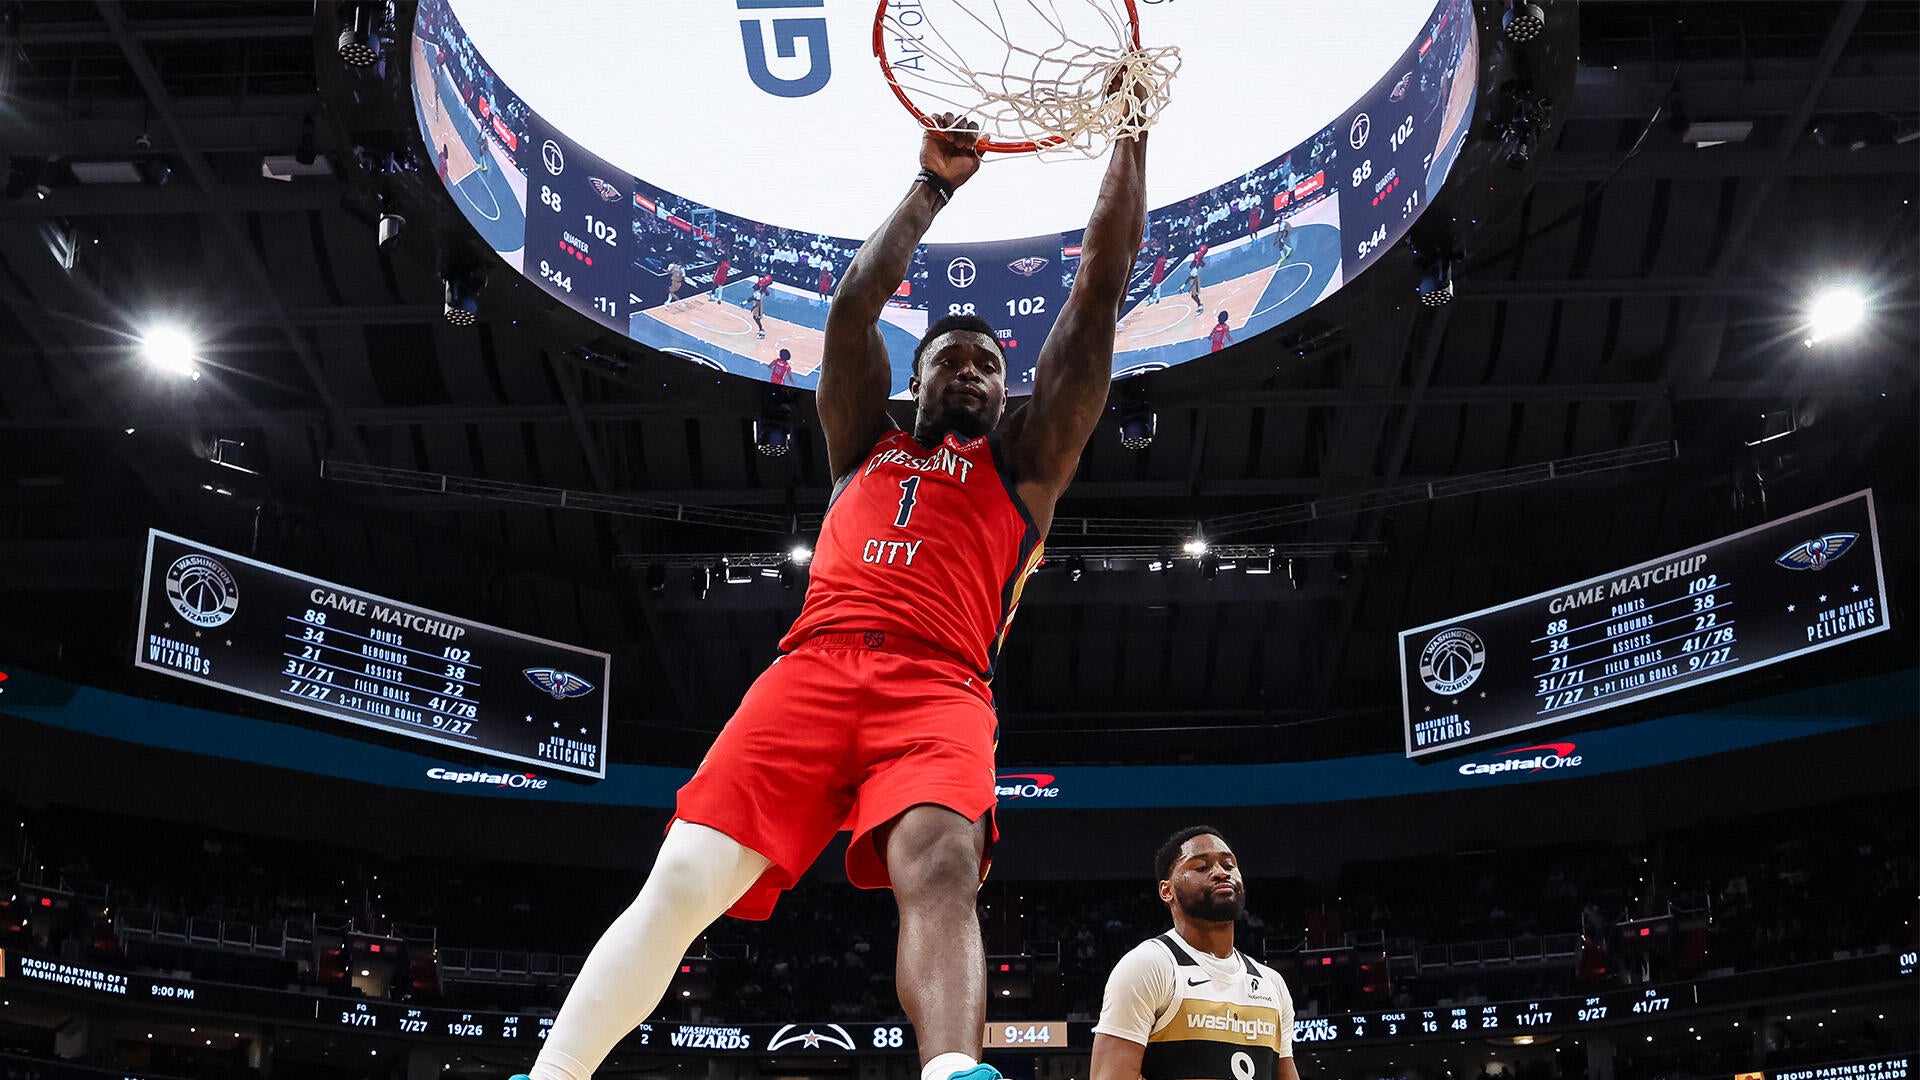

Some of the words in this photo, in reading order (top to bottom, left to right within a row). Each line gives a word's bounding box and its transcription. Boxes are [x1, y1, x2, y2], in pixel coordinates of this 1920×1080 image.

[893, 34, 925, 71] Art
[1390, 115, 1413, 152] 102
[1352, 159, 1372, 187] 88
[541, 185, 562, 213] 88
[585, 215, 617, 247] 102
[1358, 223, 1387, 259] 9:44
[563, 231, 589, 254] QUARTER
[540, 260, 573, 293] 9:44
[594, 296, 616, 317] :11
[948, 303, 976, 316] 88
[1006, 297, 1046, 317] 102
[864, 447, 975, 484] CRESCENT
[893, 475, 921, 528] 1
[862, 538, 923, 566] CITY
[176, 557, 231, 584] WASHINGTON
[1548, 585, 1605, 615] GAME
[1609, 554, 1708, 598] MATCHUP
[178, 603, 222, 623] WIZARDS
[310, 588, 368, 617] GAME
[370, 605, 466, 641] MATCHUP
[1546, 618, 1568, 636] 88
[1611, 598, 1645, 617] POINTS
[1688, 574, 1717, 595] 102
[1818, 609, 1836, 622] NEW
[1839, 597, 1874, 615] ORLEANS
[1548, 636, 1570, 653] 34
[1606, 614, 1654, 637] REBOUNDS
[1692, 594, 1715, 612] 38
[1807, 608, 1875, 642] PELICANS
[150, 634, 200, 656] WASHINGTON
[304, 609, 327, 625] 88
[370, 628, 403, 646] POINTS
[443, 646, 471, 663] 102
[1426, 630, 1475, 655] WASHINGTON
[1550, 655, 1568, 671] 21
[1612, 633, 1651, 654] ASSISTS
[1694, 613, 1716, 631] 22
[150, 644, 210, 675] WIZARDS
[303, 627, 325, 643] 34
[362, 644, 408, 665] REBOUNDS
[444, 664, 466, 680] 38
[1538, 669, 1584, 693] 31/71
[1605, 659, 1630, 674] FIELD
[1633, 649, 1662, 667] GOALS
[1681, 627, 1734, 653] 41/78
[302, 645, 321, 660] 21
[365, 663, 403, 682] ASSISTS
[442, 682, 465, 697] 22
[1544, 687, 1584, 711] 7/27
[1593, 680, 1616, 697] 3-PT
[1620, 673, 1645, 690] FIELD
[1649, 663, 1678, 682] GOALS
[1688, 647, 1731, 671] 9/27
[285, 660, 335, 683] 31/71
[354, 679, 379, 695] FIELD
[382, 685, 410, 703] GOALS
[428, 697, 477, 718] 41/78
[1434, 674, 1474, 692] WIZARDS
[288, 679, 331, 701] 7/27
[339, 693, 362, 709] 3-PT
[366, 700, 391, 716] FIELD
[394, 707, 422, 723] GOALS
[432, 715, 472, 735] 9/27
[1414, 714, 1459, 732] WASHINGTON
[1415, 720, 1471, 746] WIZARDS
[538, 741, 595, 767] PELICANS
[550, 735, 565, 746] NEW
[567, 739, 596, 753] ORLEANS
[21, 957, 57, 971] PROUD
[59, 965, 104, 981] PARTNER
[107, 974, 121, 984] OF
[22, 967, 91, 988] WASHINGTON
[94, 980, 127, 995] WIZAR
[151, 985, 174, 997] 9:00
[176, 988, 195, 999] PM
[1585, 997, 1600, 1006] 3PT
[1645, 989, 1656, 997] FG
[356, 1003, 367, 1012] FG
[407, 1009, 421, 1018] 3PT
[1423, 1011, 1434, 1019] TO
[1451, 1008, 1466, 1017] REB
[1482, 1006, 1497, 1015] AST
[1529, 1003, 1539, 1011] FT
[1577, 1007, 1607, 1022] 9/27
[1632, 998, 1670, 1014] 41/77
[341, 1011, 377, 1027] 31/71
[400, 1019, 428, 1033] 7/27
[462, 1014, 472, 1022] FT
[504, 1016, 518, 1024] AST
[539, 1018, 554, 1026] REB
[640, 1023, 653, 1032] TOL
[1186, 1009, 1277, 1040] washington
[1352, 1016, 1366, 1024] TOL
[1381, 1013, 1406, 1022] FOULS
[1421, 1020, 1437, 1033] 16
[1451, 1018, 1468, 1030] 48
[1482, 1016, 1498, 1028] 22
[1516, 1012, 1553, 1025] 11/17
[447, 1023, 483, 1037] 19/26
[502, 1026, 517, 1038] 21
[641, 1033, 649, 1045] 2
[680, 1025, 741, 1036] WASHINGTON
[873, 1027, 903, 1048] 88
[1004, 1025, 1050, 1044] 9:44
[1355, 1026, 1363, 1036] 4
[1389, 1023, 1397, 1035] 3
[670, 1032, 751, 1049] WIZARDS
[1776, 1071, 1813, 1080] PROUD
[1816, 1064, 1865, 1078] PARTNER
[1868, 1062, 1883, 1071] OF
[1886, 1059, 1908, 1069] THE
[1855, 1069, 1907, 1080] WIZARDS
